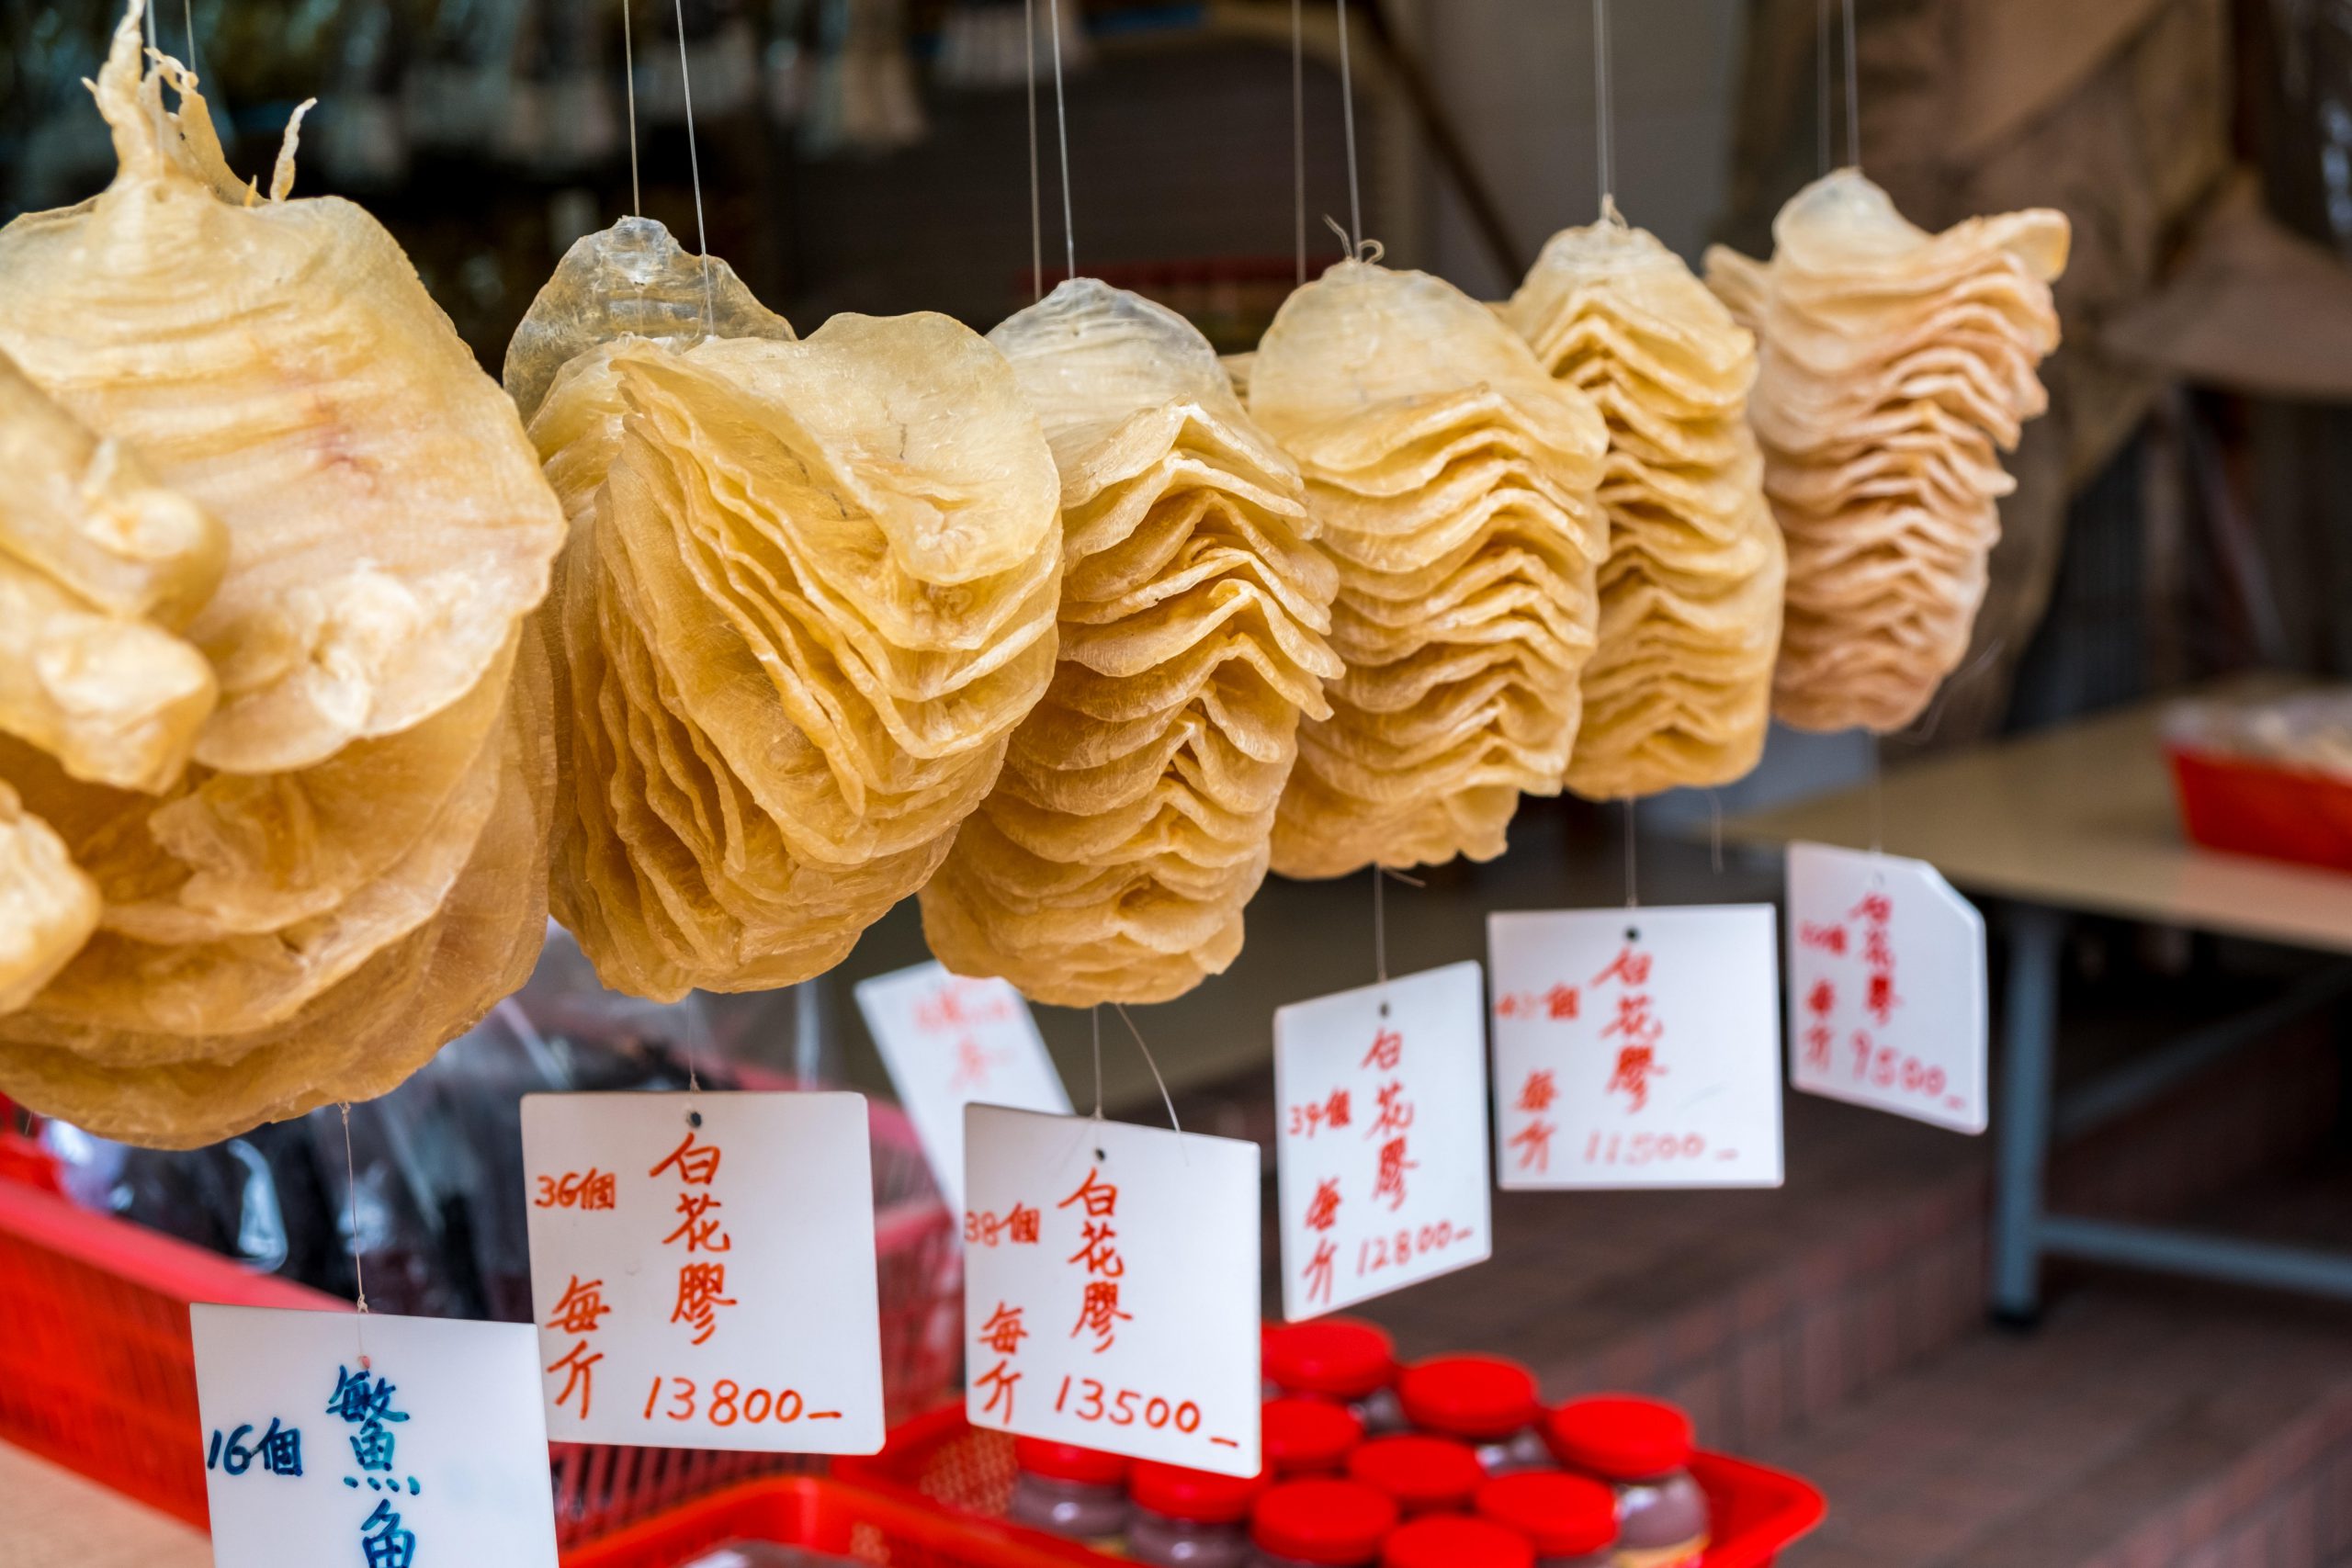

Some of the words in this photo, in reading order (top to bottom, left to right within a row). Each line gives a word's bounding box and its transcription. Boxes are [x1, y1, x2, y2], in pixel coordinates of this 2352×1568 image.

[1590, 947, 1668, 1112] 白花膠
[535, 1167, 616, 1210] 36個
[1362, 1029, 1419, 1212] 白花膠
[649, 1132, 737, 1345] 白花膠
[965, 1201, 1040, 1247] 38個
[1057, 1168, 1133, 1353] 白花膠
[207, 1417, 303, 1476] 16個
